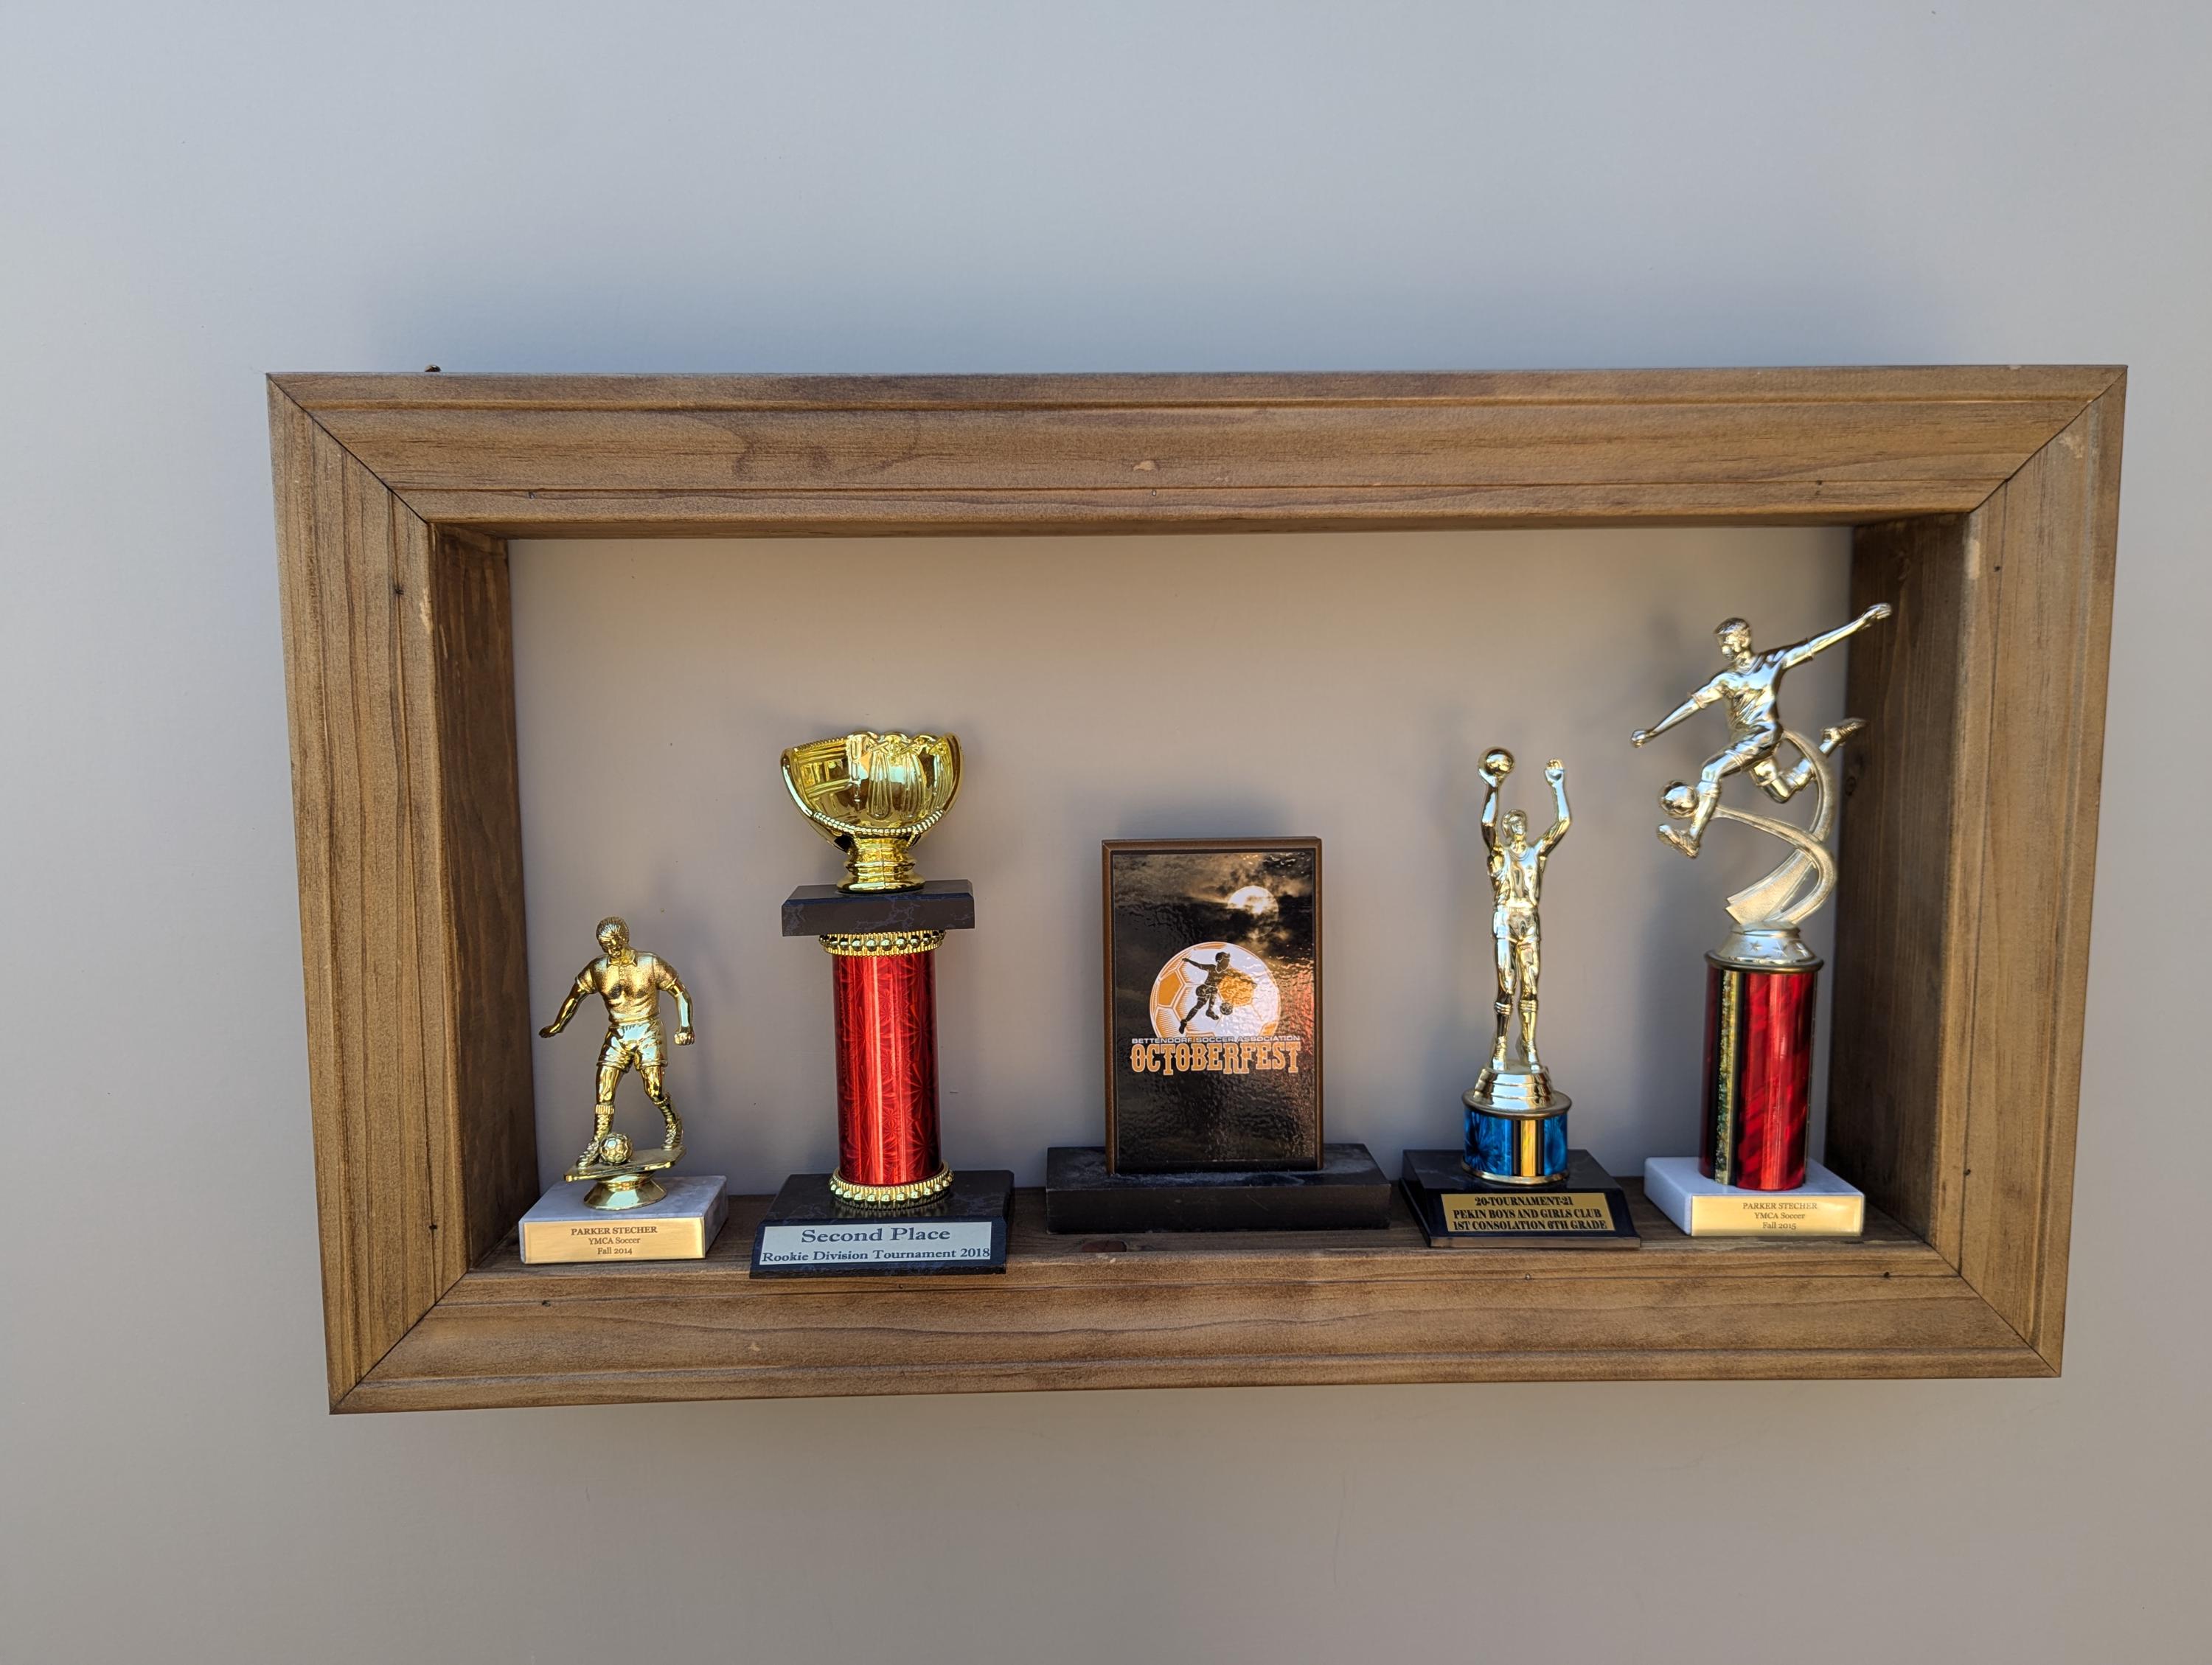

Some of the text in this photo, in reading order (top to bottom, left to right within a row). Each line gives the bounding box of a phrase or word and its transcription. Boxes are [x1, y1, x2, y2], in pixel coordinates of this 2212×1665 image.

[1130, 1042, 1301, 1075] OCTOBERFEST
[1475, 1196, 1573, 1206] 20-TOURNAMENT-21
[1453, 1209, 1601, 1219] PEKIN BOYS AND GIRLS CLUB
[1453, 1221, 1471, 1230] 1ST
[1472, 1220, 1545, 1230] CONSOLATION
[1571, 1220, 1607, 1229] GRADE
[1778, 1222, 1797, 1230] 2015
[571, 1226, 658, 1236] PARKER STECHER
[801, 1227, 950, 1243] Second Place
[762, 1248, 990, 1262] Rookie Division Tournament 2018
